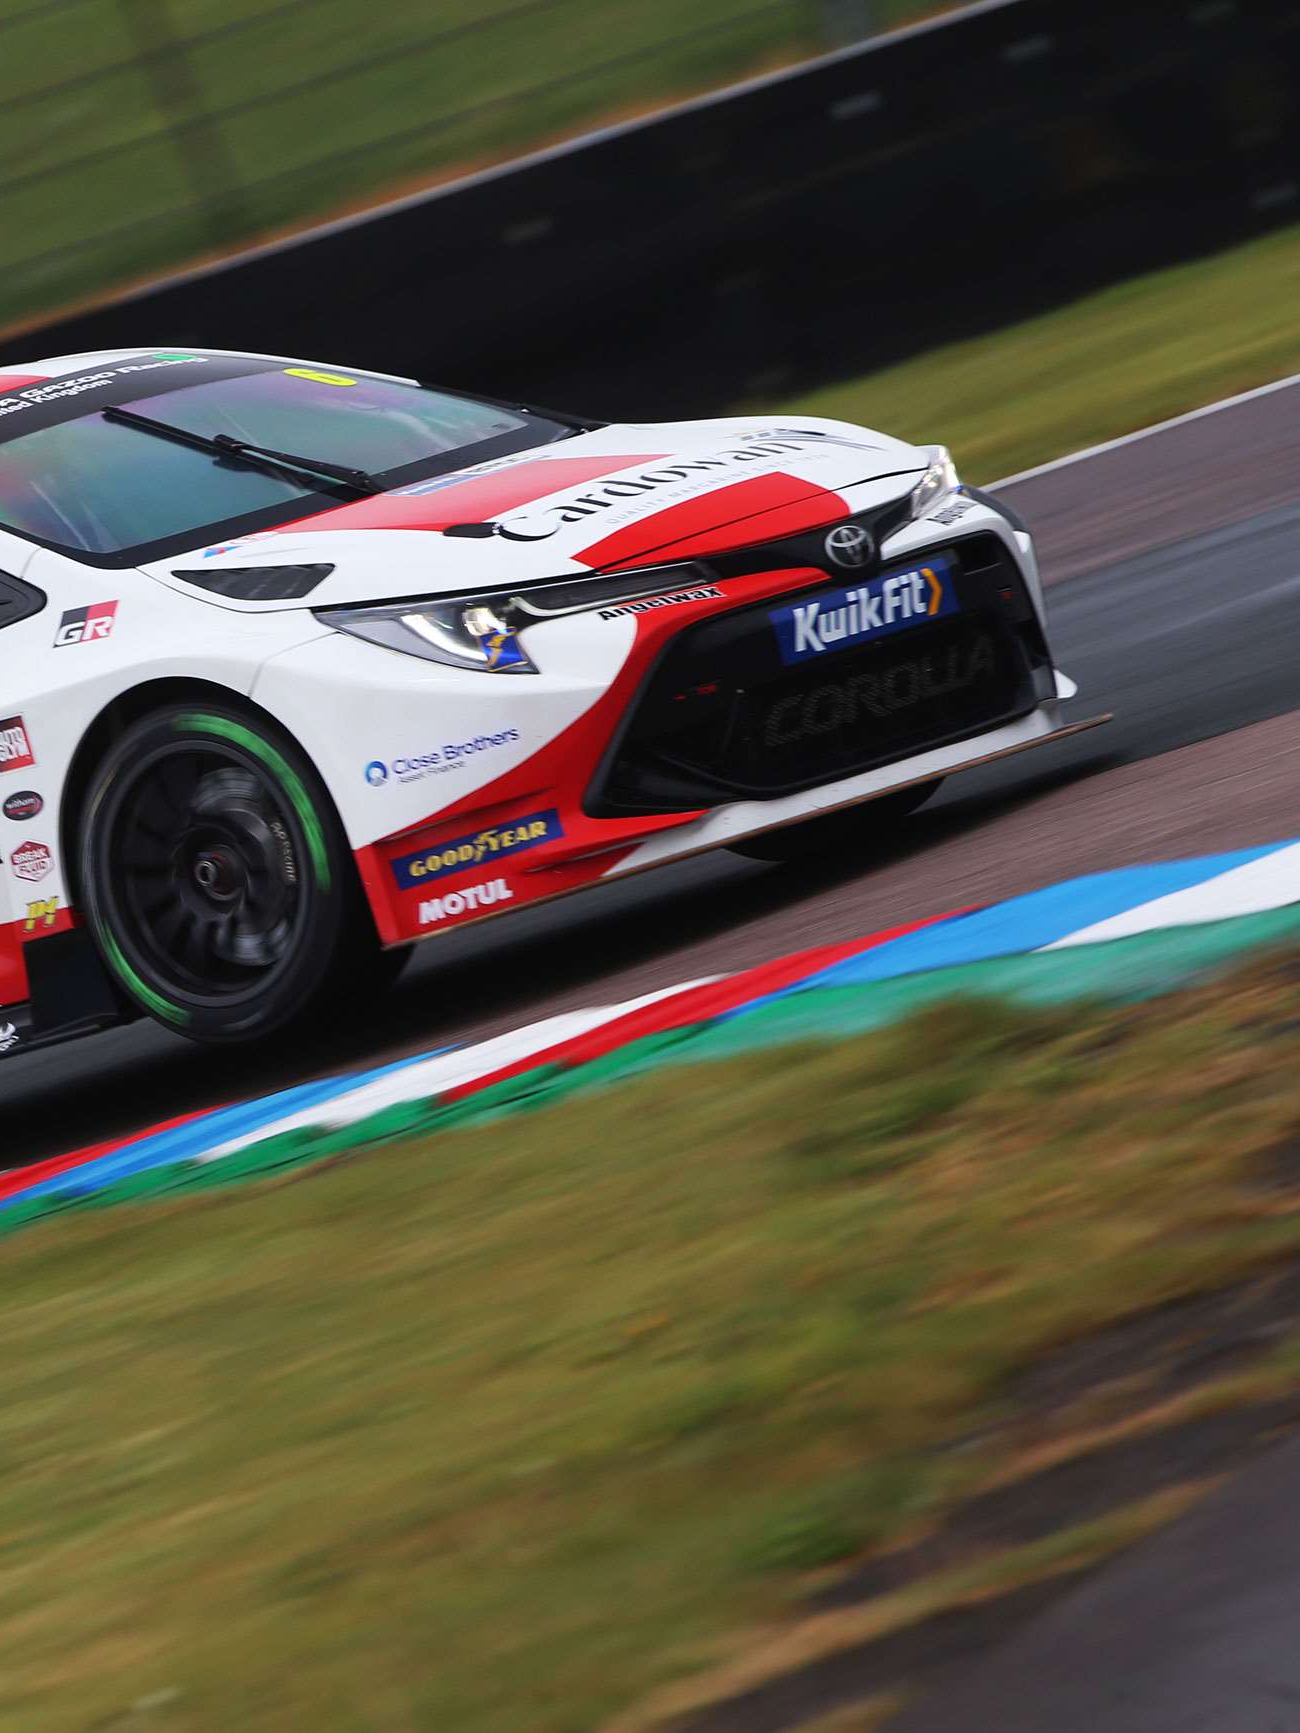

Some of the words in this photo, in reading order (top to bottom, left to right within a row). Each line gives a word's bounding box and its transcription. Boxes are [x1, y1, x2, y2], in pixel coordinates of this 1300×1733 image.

[20, 371, 116, 398] GAZOO
[33, 379, 113, 404] Kingdom
[283, 367, 357, 387] 6
[497, 442, 804, 541] Cardowan
[598, 585, 723, 622] Angelwax
[54, 615, 116, 646] GR
[764, 630, 996, 748] COROLLA
[391, 752, 440, 775] Close
[442, 728, 521, 760] Brothers
[408, 820, 548, 878] GOODYEAR
[418, 878, 514, 924] MOTUL
